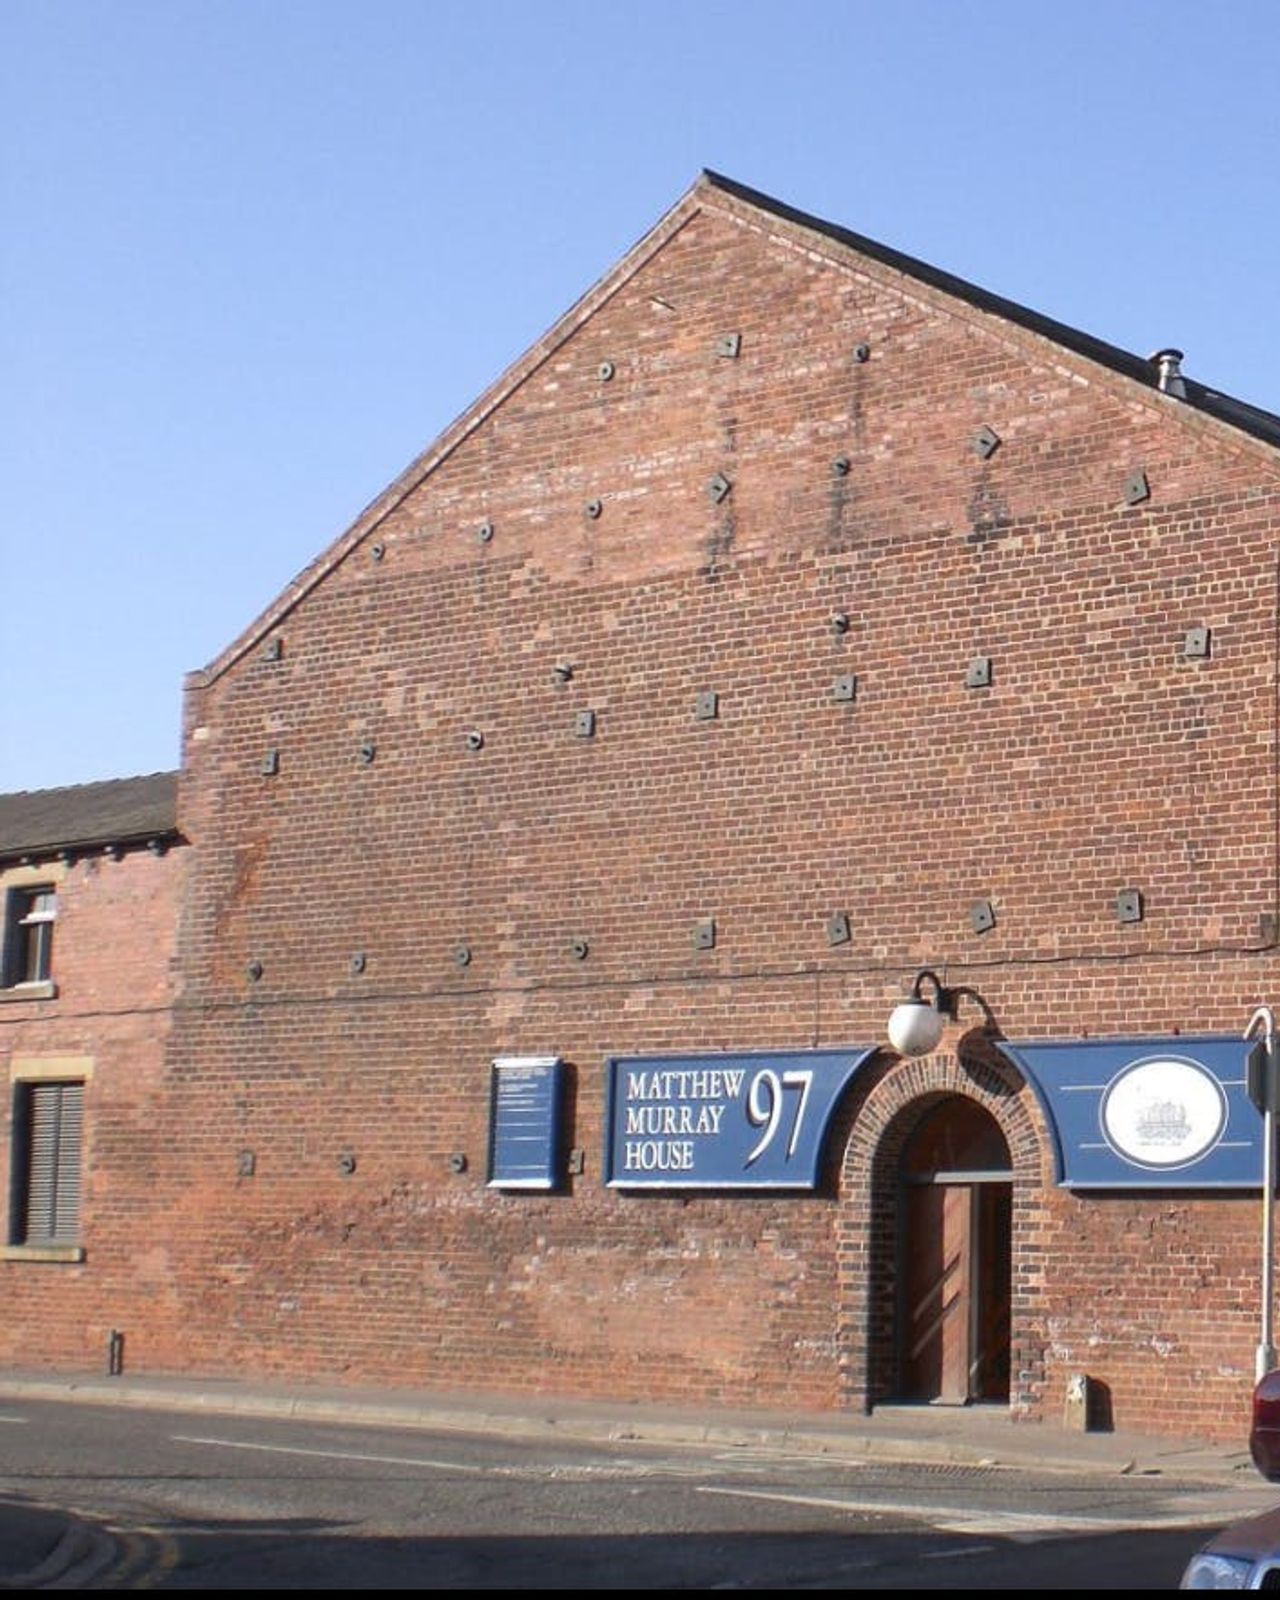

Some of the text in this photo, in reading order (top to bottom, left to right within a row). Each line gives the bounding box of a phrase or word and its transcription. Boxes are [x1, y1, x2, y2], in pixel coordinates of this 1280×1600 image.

[627, 1070, 745, 1100] MATTHEW
[625, 1105, 726, 1135] MURRAY
[747, 1069, 814, 1165] 97
[624, 1141, 695, 1171] HOUSE
